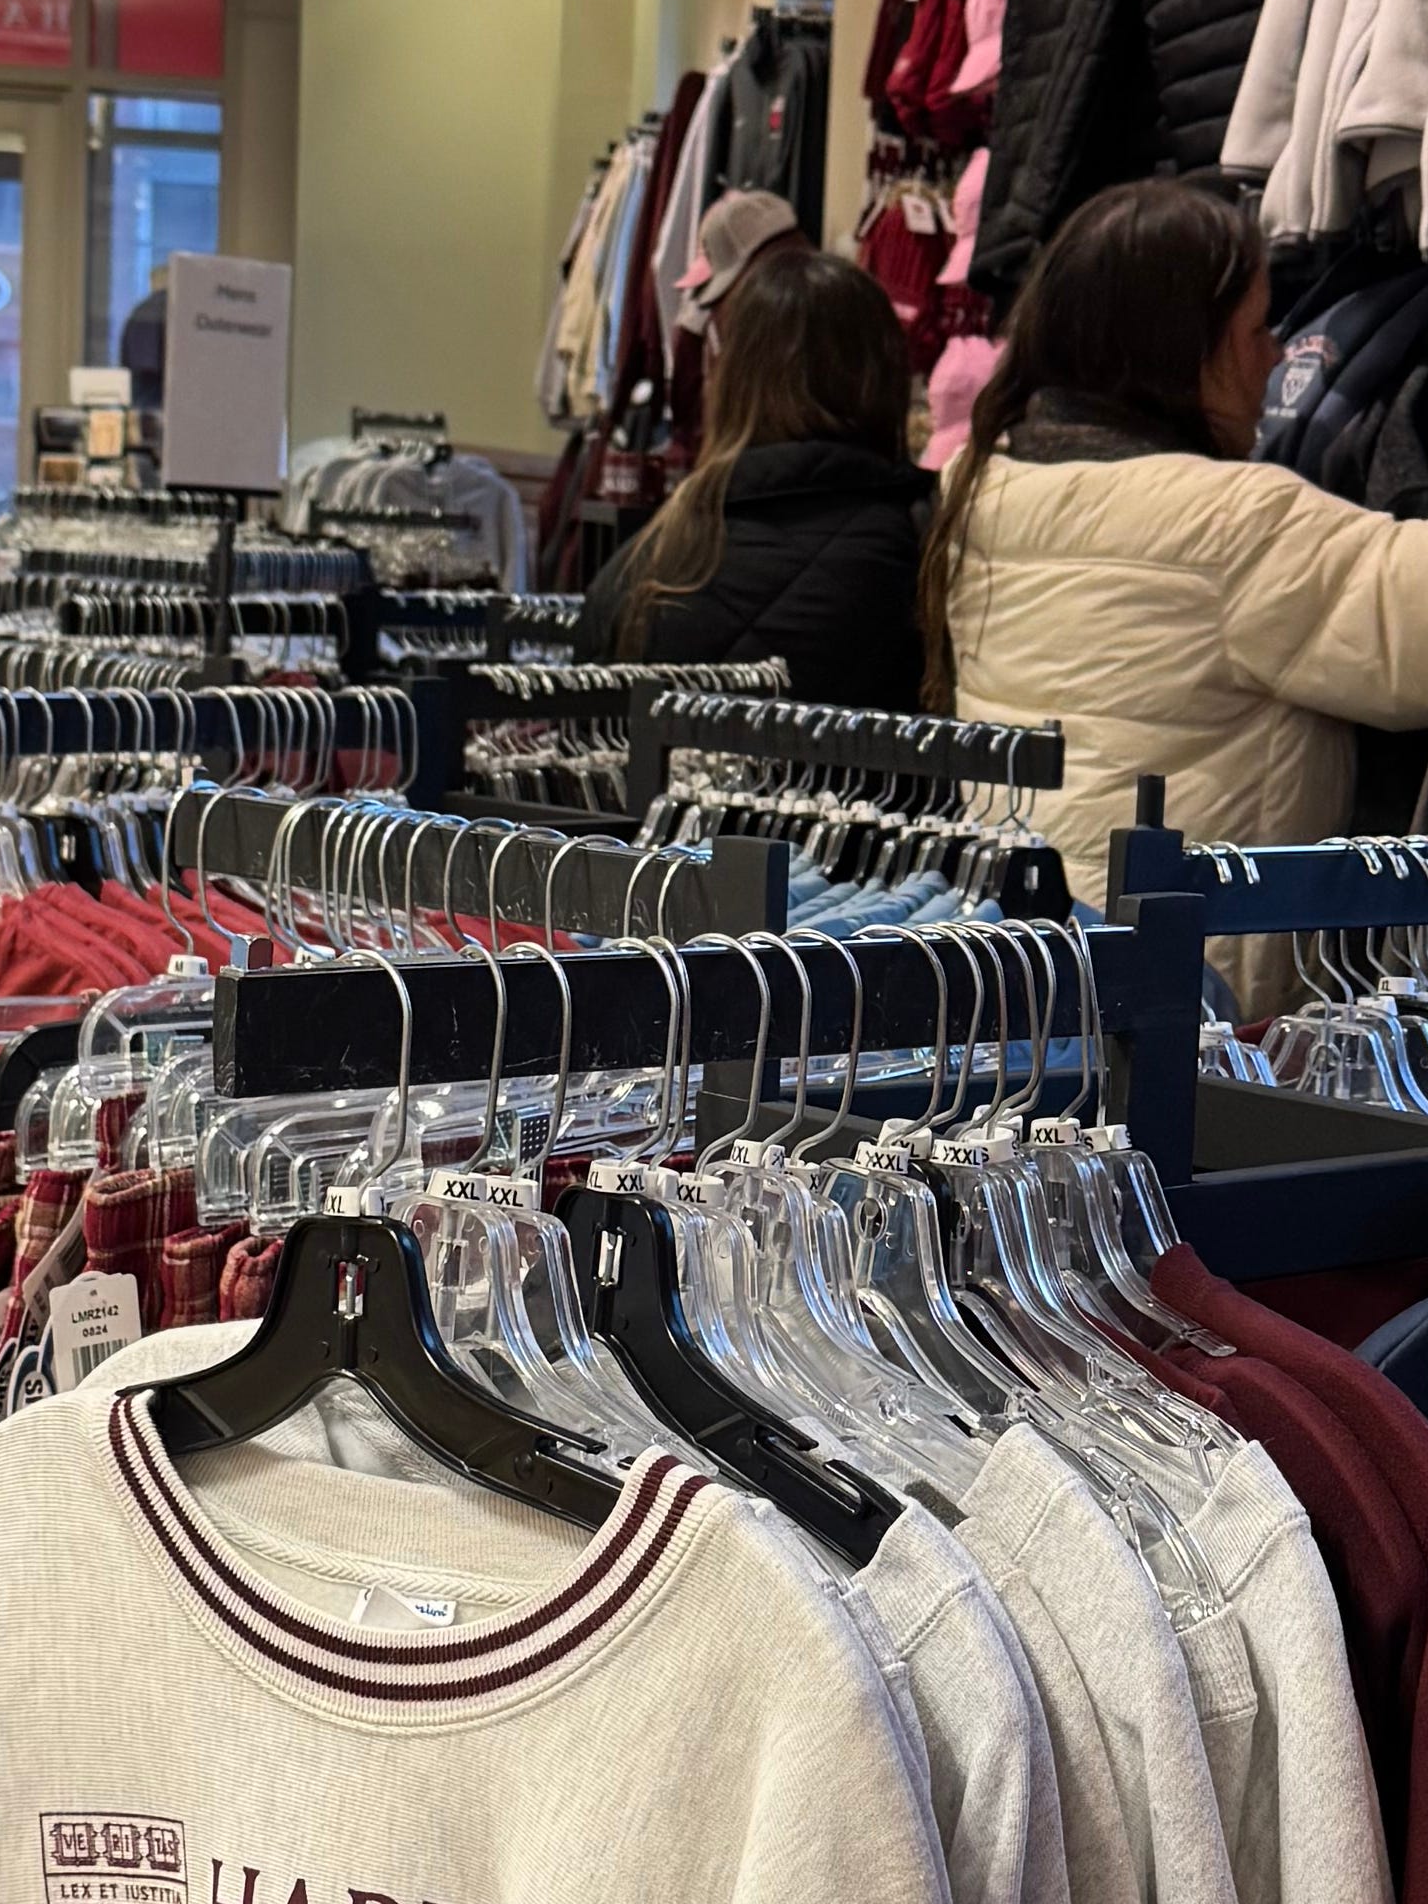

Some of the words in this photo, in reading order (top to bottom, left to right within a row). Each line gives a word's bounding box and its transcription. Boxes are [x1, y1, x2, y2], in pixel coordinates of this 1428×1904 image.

[443, 1180, 481, 1201] XXL
[615, 1174, 645, 1192] XXL
[487, 1186, 524, 1208] XXL
[60, 1883, 92, 1899] LEX
[99, 1883, 119, 1899] ET
